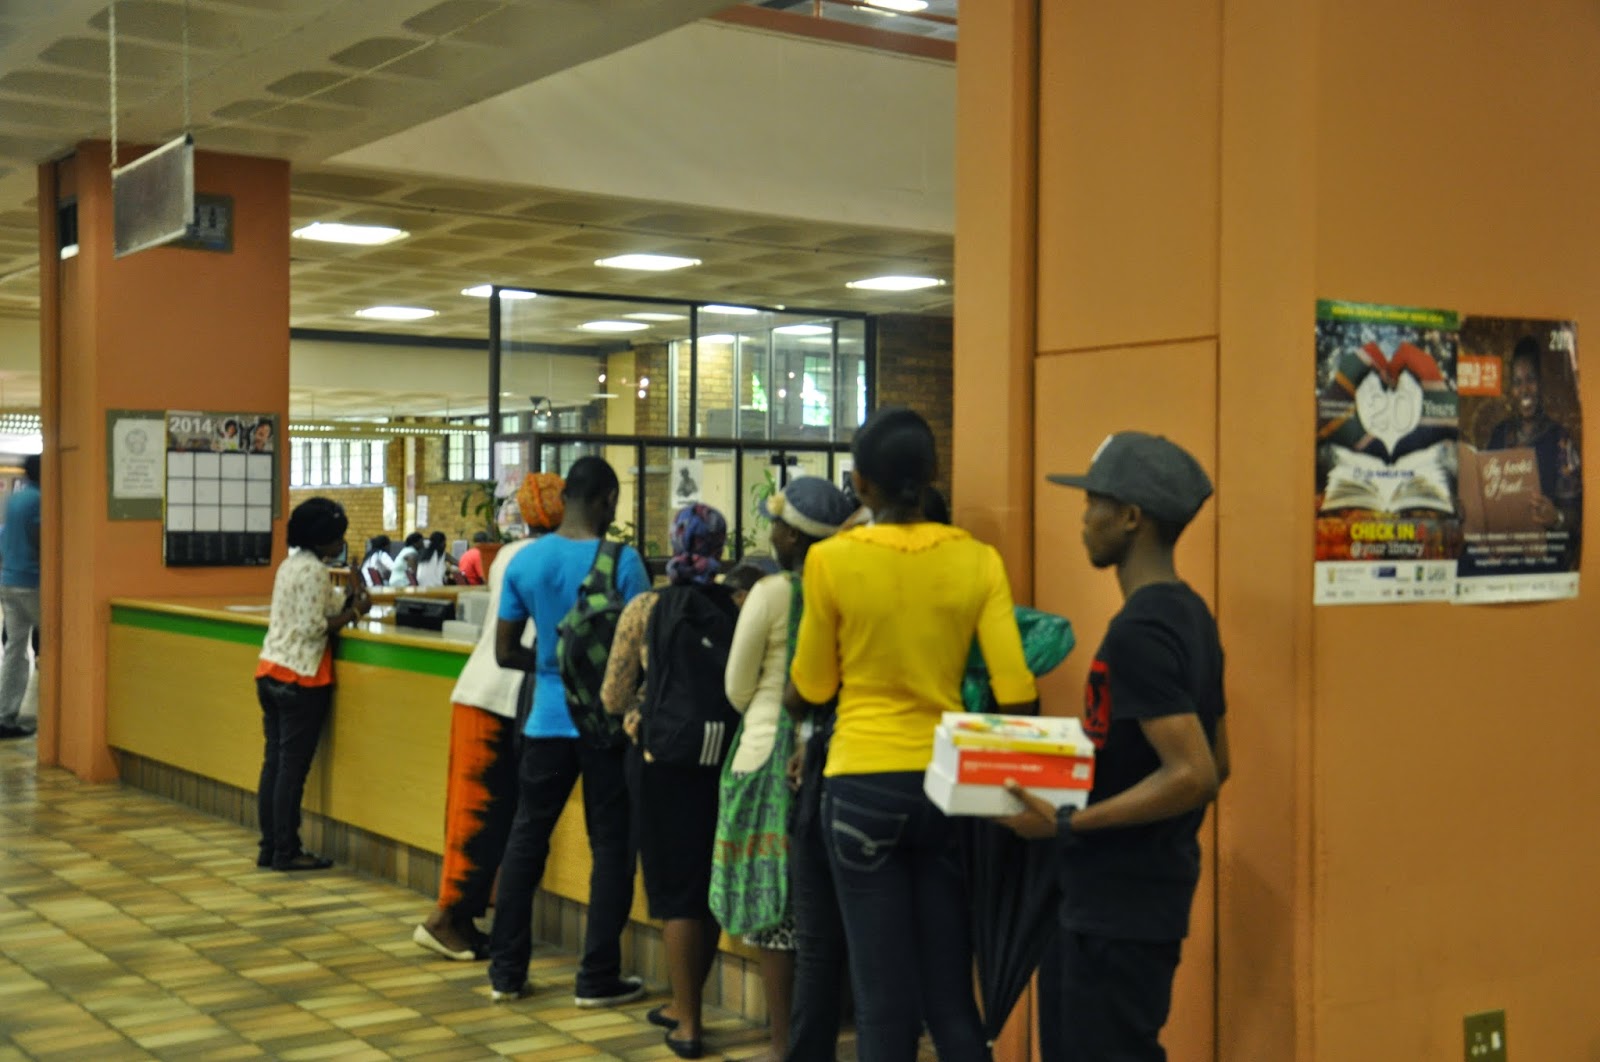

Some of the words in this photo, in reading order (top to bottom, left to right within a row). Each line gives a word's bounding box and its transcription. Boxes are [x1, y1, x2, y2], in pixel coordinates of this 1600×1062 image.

[169, 416, 212, 433] 2014
[1350, 522, 1395, 541] CHECK
[1397, 522, 1415, 541] IN
